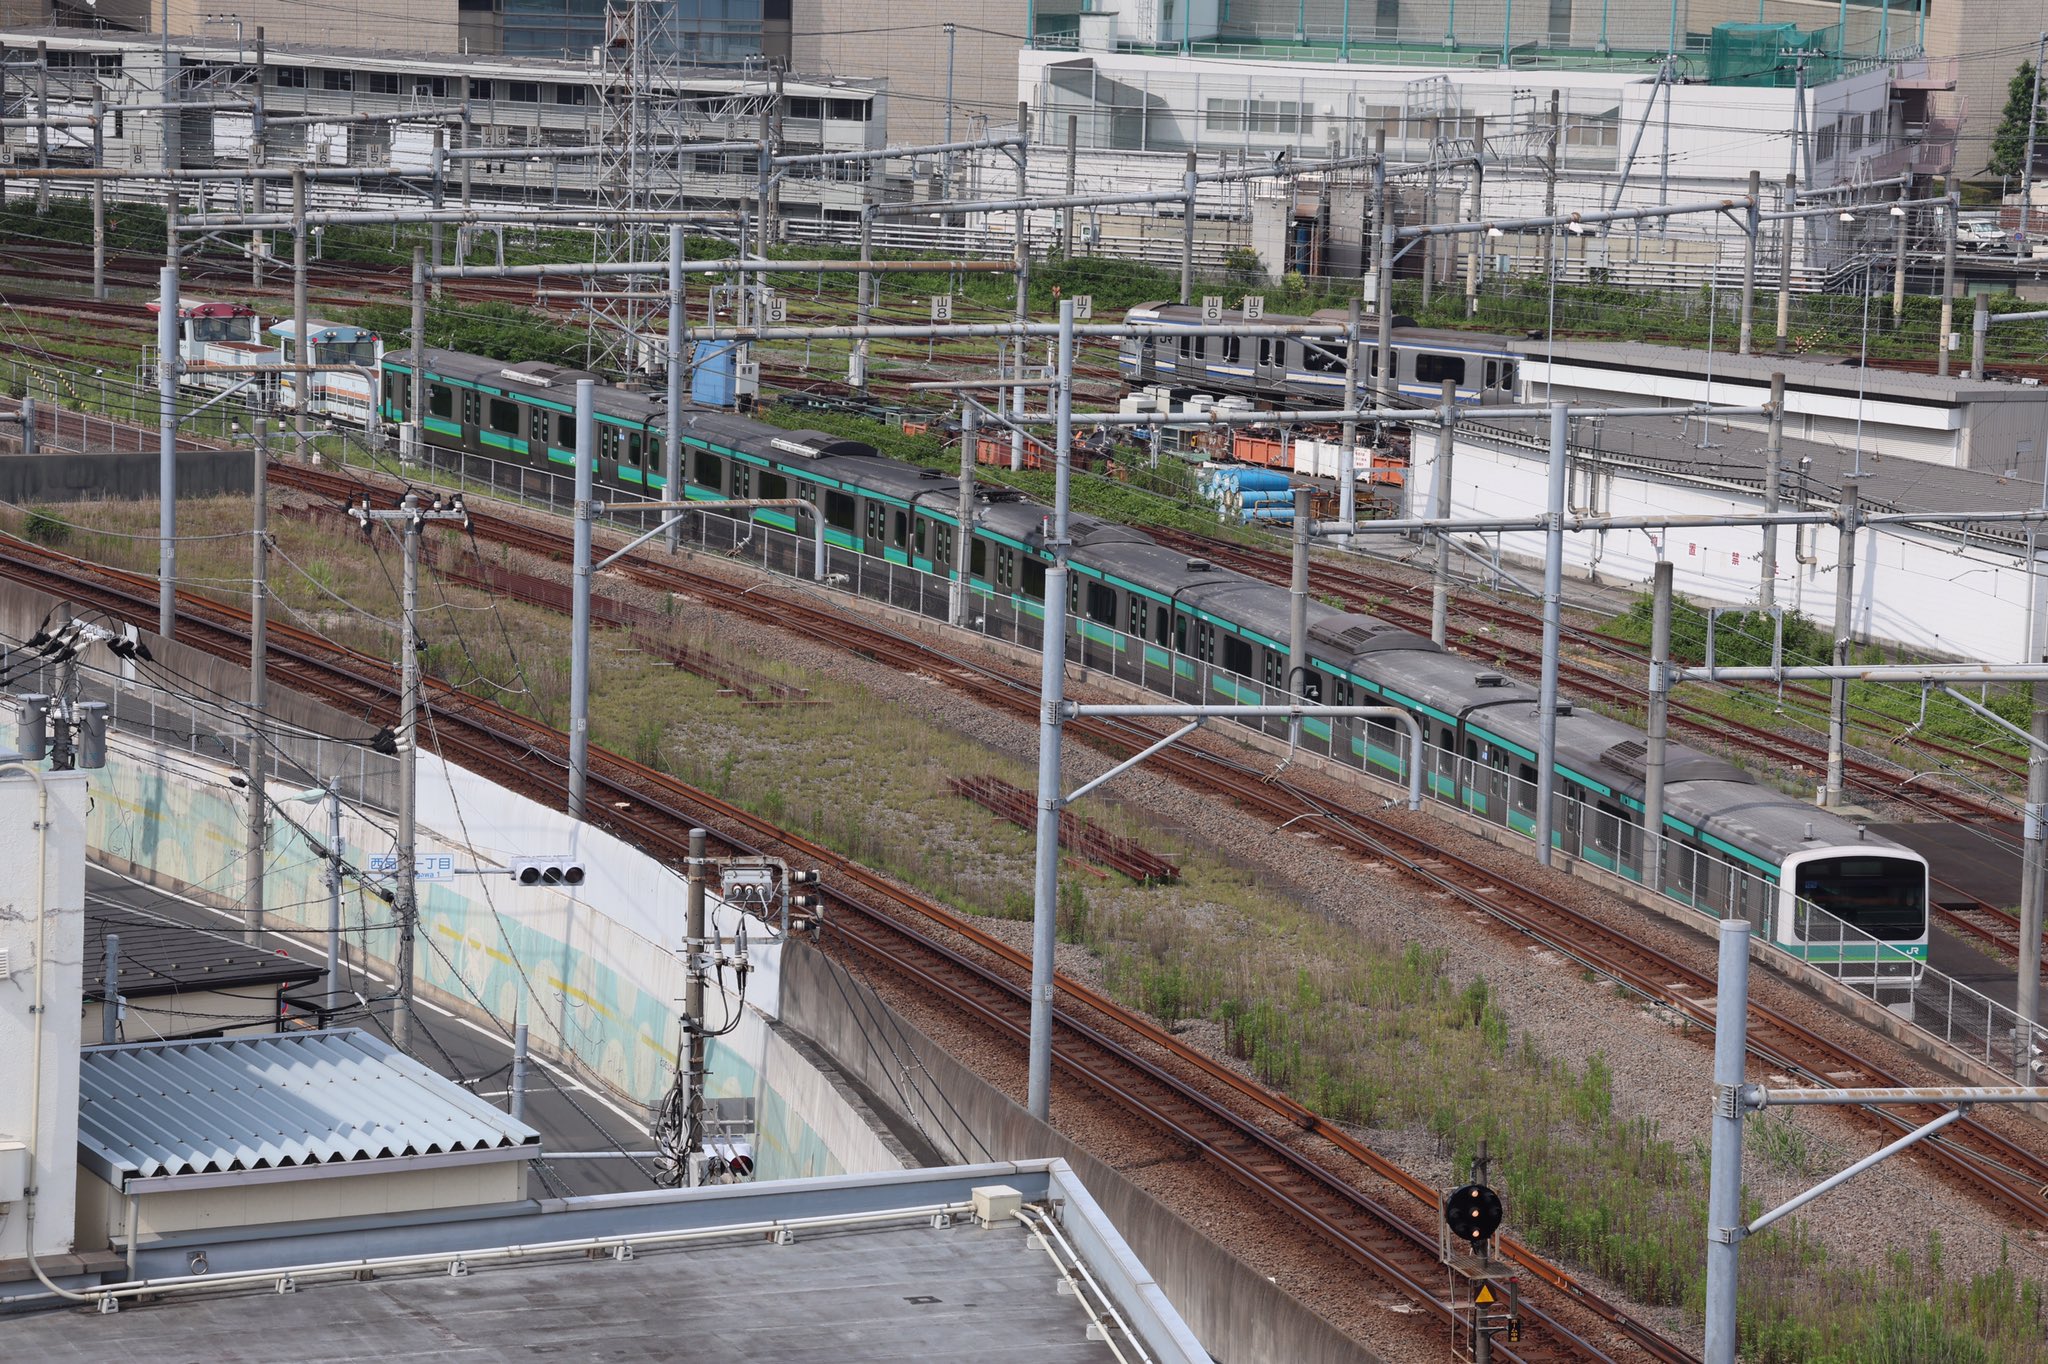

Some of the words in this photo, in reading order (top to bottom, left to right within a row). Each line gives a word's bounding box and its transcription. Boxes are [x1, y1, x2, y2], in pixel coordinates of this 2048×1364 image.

[371, 858, 450, 869] 西品一丁目
[1906, 947, 1919, 955] JR
